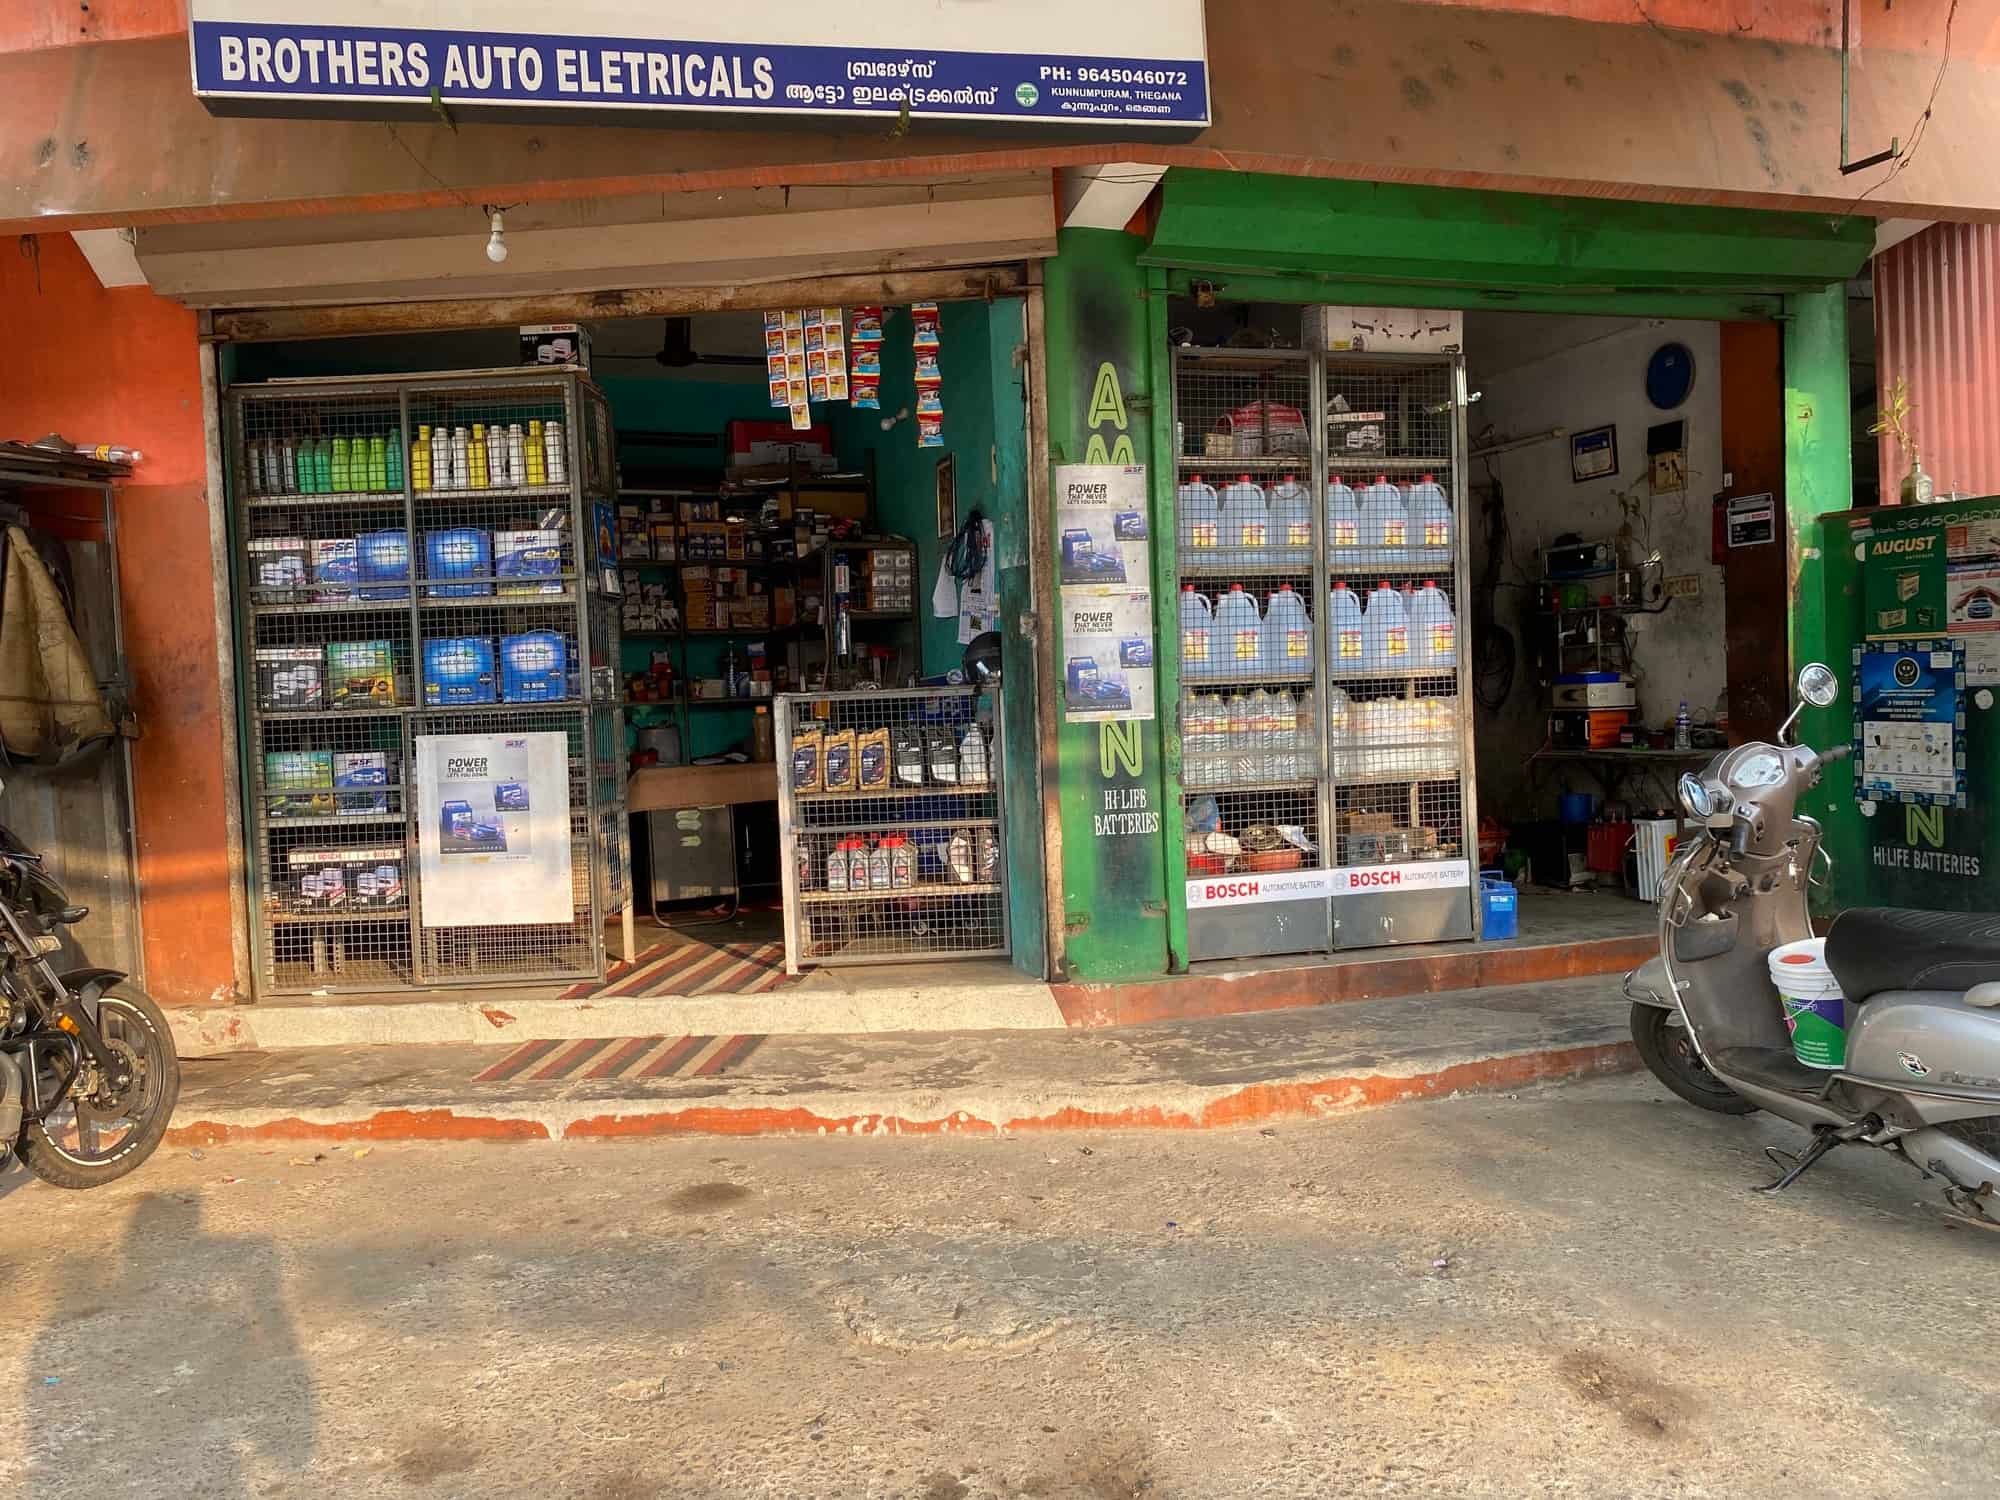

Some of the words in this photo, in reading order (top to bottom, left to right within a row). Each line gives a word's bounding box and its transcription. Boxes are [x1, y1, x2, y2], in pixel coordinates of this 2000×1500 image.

[220, 36, 429, 87] BROTHERS
[444, 45, 542, 91] AUTO
[556, 49, 775, 100] ELETRICALS
[1040, 67, 1071, 80] PH:
[1078, 68, 1187, 85] 9645046072
[786, 85, 844, 104] ആട്ടോ
[1051, 87, 1133, 100] KUNNUMPURAM,
[1135, 90, 1182, 101] THEGANA
[1068, 484, 1108, 494] POWER
[1872, 535, 1937, 556] AUGUST
[1073, 612, 1113, 622] POWER
[448, 757, 488, 768] POWER
[1094, 812, 1160, 836] BATTERIES
[1905, 803, 1945, 848] N
[1913, 850, 1980, 876] BATTERIES
[1350, 870, 1401, 887] BOSCH
[1404, 871, 1438, 881] AUTOMOTIVE
[1439, 869, 1465, 879] BATTERY
[1205, 881, 1259, 899] BOSCH
[1262, 880, 1298, 892] AUTOMOTIVE
[1298, 880, 1325, 889] BATTERY
